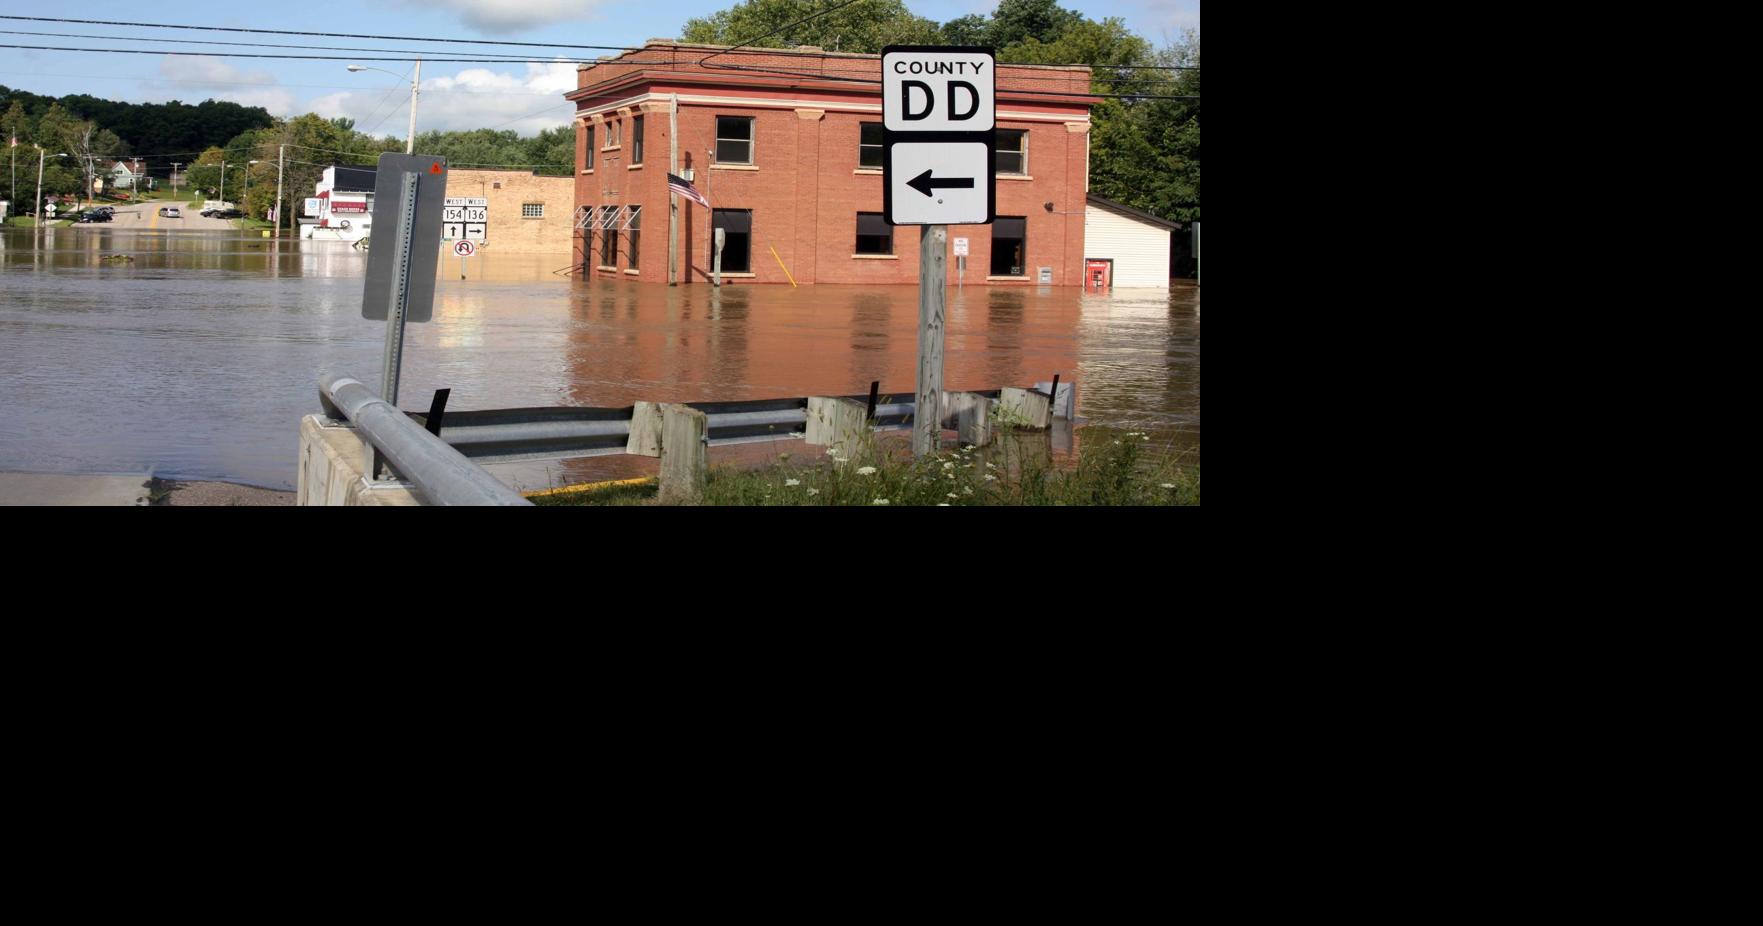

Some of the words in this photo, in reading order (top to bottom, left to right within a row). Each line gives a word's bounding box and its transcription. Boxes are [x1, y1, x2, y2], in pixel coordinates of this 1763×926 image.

[894, 61, 984, 75] COUNTY
[446, 210, 462, 219] 154
[468, 210, 484, 219] 136
